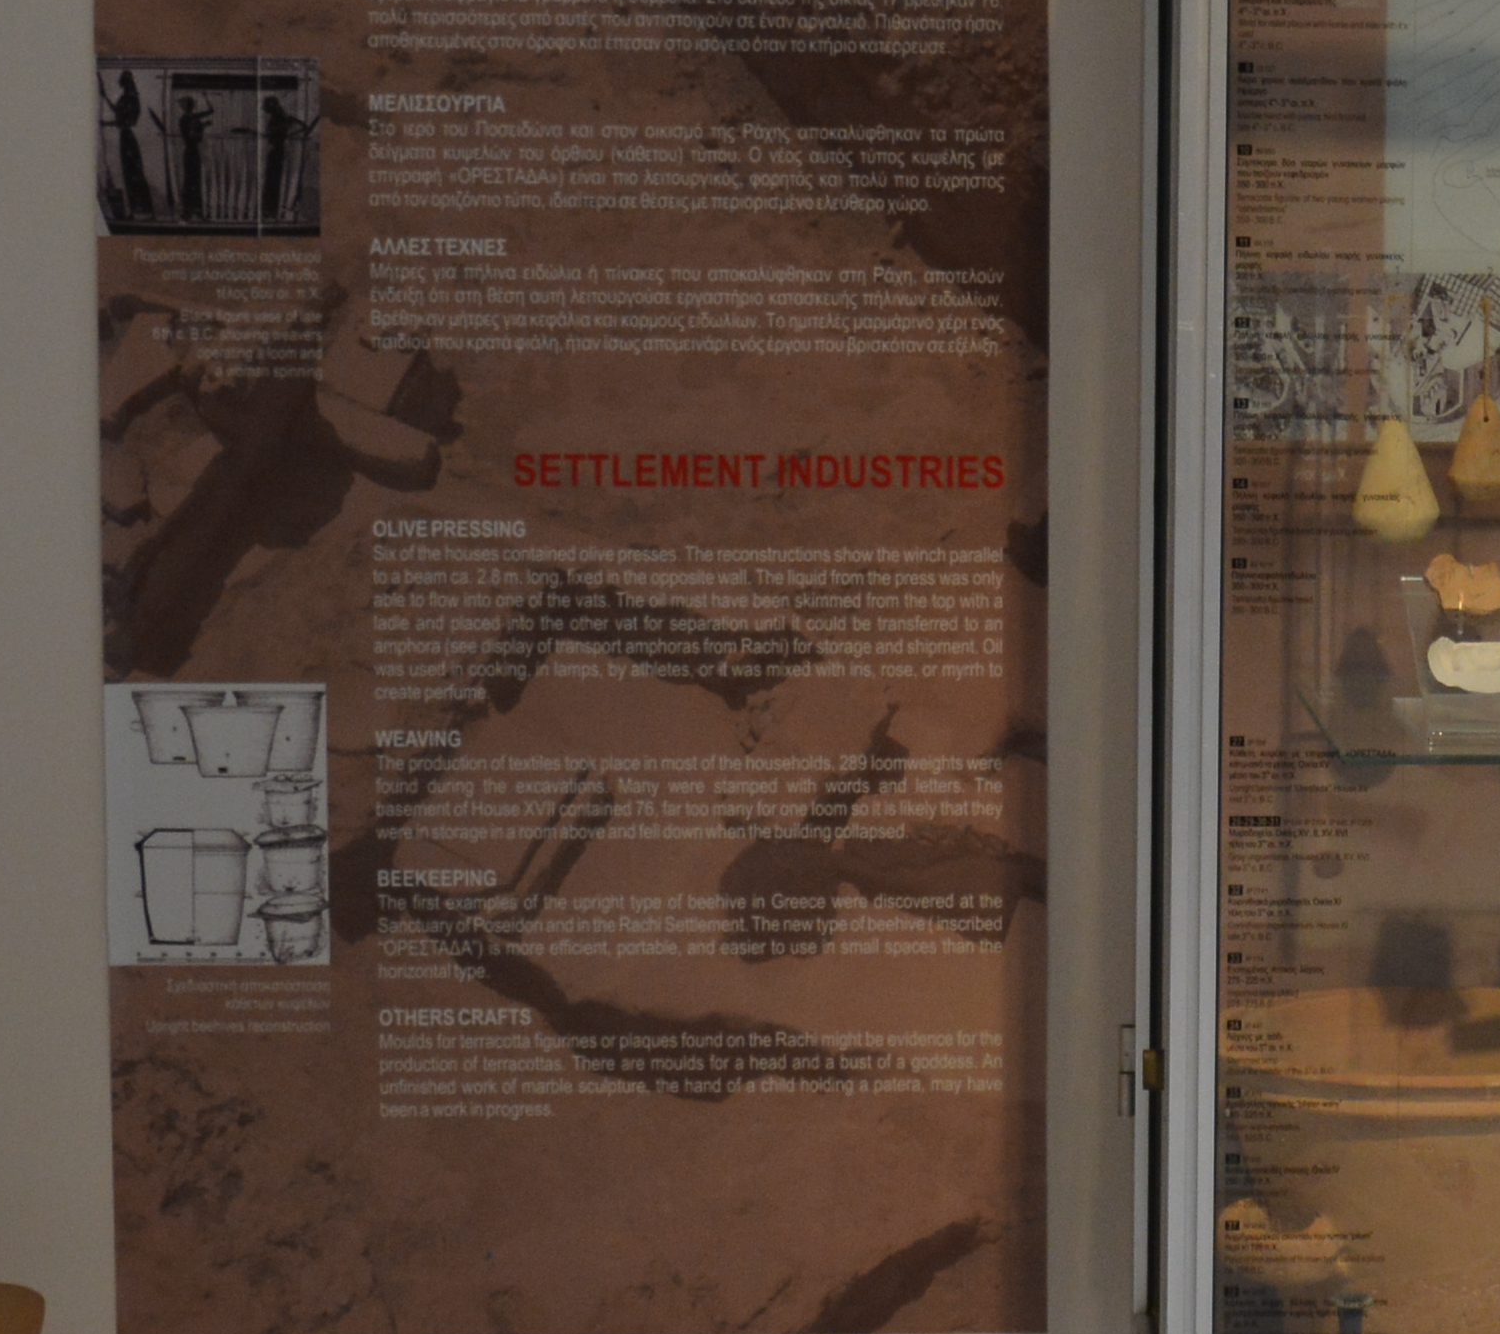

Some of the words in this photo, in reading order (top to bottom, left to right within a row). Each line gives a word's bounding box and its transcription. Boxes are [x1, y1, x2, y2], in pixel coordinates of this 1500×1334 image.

[368, 94, 505, 113] ΜΕΛΙΣΣΟΥΡΓΙΑ
[368, 237, 430, 256] ΑΛΛΕΣ
[436, 237, 508, 256] ΤΕΧΝΕΣ
[513, 453, 762, 488] SETTLEMENT
[777, 454, 1005, 488] INDUSTRIES
[371, 519, 427, 538] OLIVE
[430, 519, 526, 538] PRESSING
[372, 545, 396, 562] Six
[399, 545, 414, 562] of
[417, 545, 442, 562] the
[444, 545, 499, 562] houses
[503, 545, 577, 562] contained
[579, 545, 615, 562] olive
[617, 549, 677, 567] presses.
[687, 545, 714, 562] The
[716, 545, 831, 562] reconstructions
[833, 545, 874, 562] show
[876, 545, 900, 562] the
[903, 545, 947, 563] winch
[948, 546, 1003, 568] parallel
[373, 683, 422, 700] create
[424, 683, 489, 705] perfume.
[374, 729, 462, 747] WEAVING
[375, 754, 405, 771] The
[408, 754, 487, 776] production
[490, 754, 505, 771] of
[508, 754, 561, 771] textiles
[564, 754, 597, 771] took
[599, 754, 641, 776] place
[644, 754, 658, 771] in
[660, 754, 698, 771] most
[701, 754, 715, 771] of
[718, 754, 742, 771] the
[744, 754, 832, 771] households.
[839, 754, 868, 771] 289
[870, 754, 964, 776] loomweights
[966, 758, 1002, 771] were
[376, 868, 498, 887] BEEKEEPING
[377, 893, 407, 910] The
[412, 893, 440, 910] first
[444, 893, 518, 915] examples
[523, 893, 538, 910] of
[543, 893, 568, 910] the
[572, 893, 625, 915] upright
[630, 893, 662, 915] type
[667, 893, 682, 910] of
[687, 893, 747, 910] beehive
[751, 892, 766, 910] in
[770, 892, 826, 909] Greece
[831, 896, 868, 909] were
[873, 892, 955, 909] discovered
[959, 892, 975, 909] at
[978, 892, 1002, 909] the
[377, 961, 452, 978] horizontal
[452, 961, 491, 983] type.
[247, 1019, 331, 1033] reconstruction
[378, 1007, 454, 1026] OTHERS
[458, 1007, 532, 1026] CRAFTS
[378, 1100, 418, 1117] been
[420, 1104, 430, 1117] a
[432, 1100, 467, 1117] work
[470, 1100, 484, 1117] in
[485, 1104, 556, 1122] progress.
